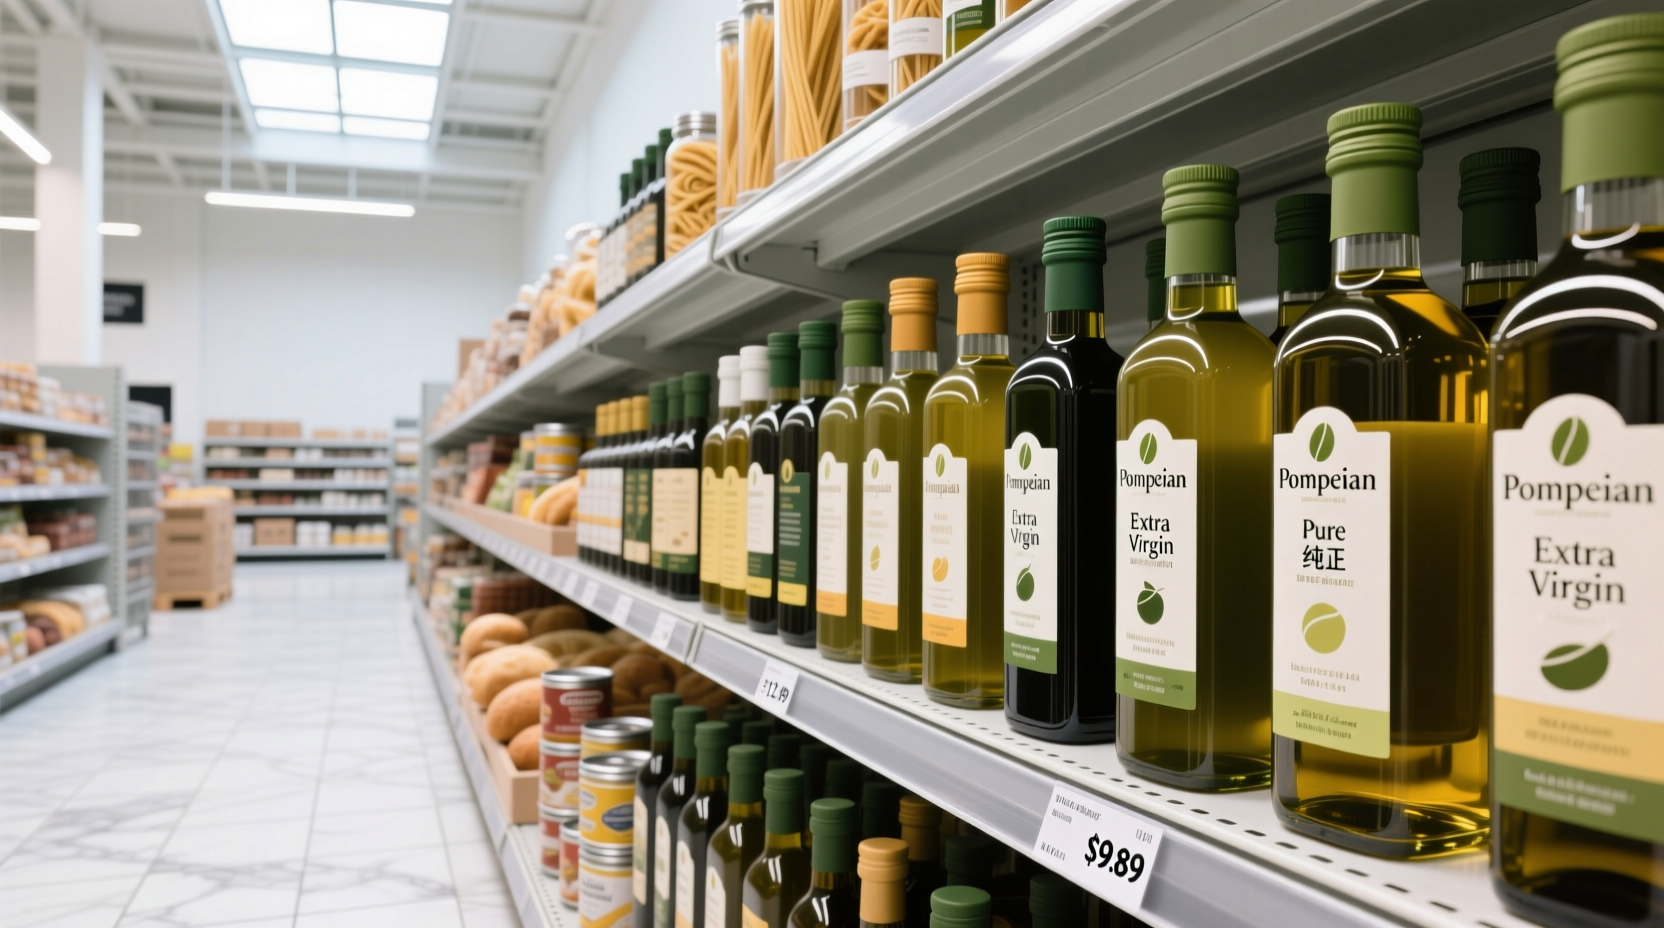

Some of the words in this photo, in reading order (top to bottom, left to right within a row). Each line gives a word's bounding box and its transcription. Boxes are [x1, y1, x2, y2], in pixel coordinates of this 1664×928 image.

[1120, 467, 1187, 495] Pompeian
[1280, 466, 1376, 497] Pompeian
[1504, 473, 1655, 511] Pompeian
[1130, 511, 1171, 533] Extra
[1302, 518, 1347, 542] Pure
[1129, 533, 1175, 560] Virgin
[1302, 544, 1346, 572] 纯正
[1534, 535, 1616, 568] Extra
[1529, 569, 1626, 609] Virgin
[1084, 832, 1145, 883] $9.89
